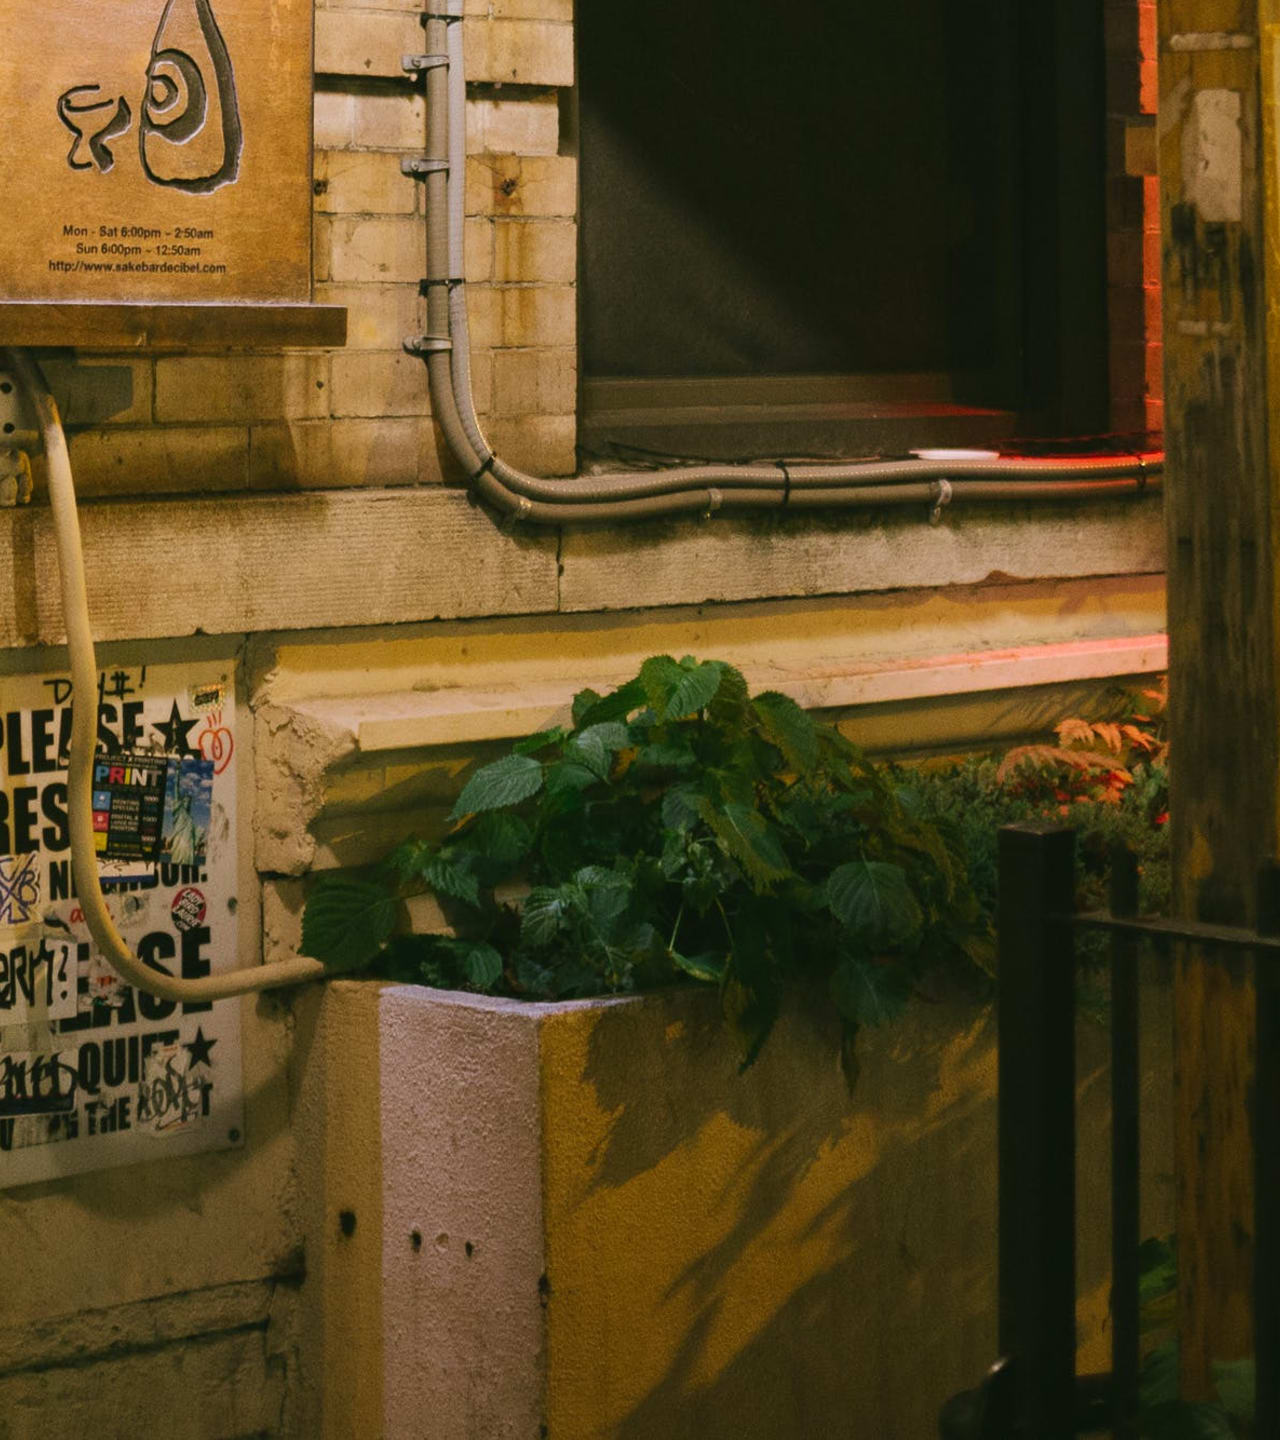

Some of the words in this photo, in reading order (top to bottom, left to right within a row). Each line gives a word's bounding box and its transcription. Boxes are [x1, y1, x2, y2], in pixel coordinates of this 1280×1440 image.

[63, 225, 88, 237] Mon
[99, 225, 118, 237] Sat
[121, 226, 161, 239] 6:00pm
[174, 227, 214, 239] 2:50am
[76, 242, 98, 254] Sun
[101, 243, 142, 257] 6:00pm
[156, 244, 201, 256] 12:50am
[48, 259, 226, 274] http://www.sakebardecibel.com
[95, 765, 162, 787] PRINT
[85, 1096, 131, 1136] THE
